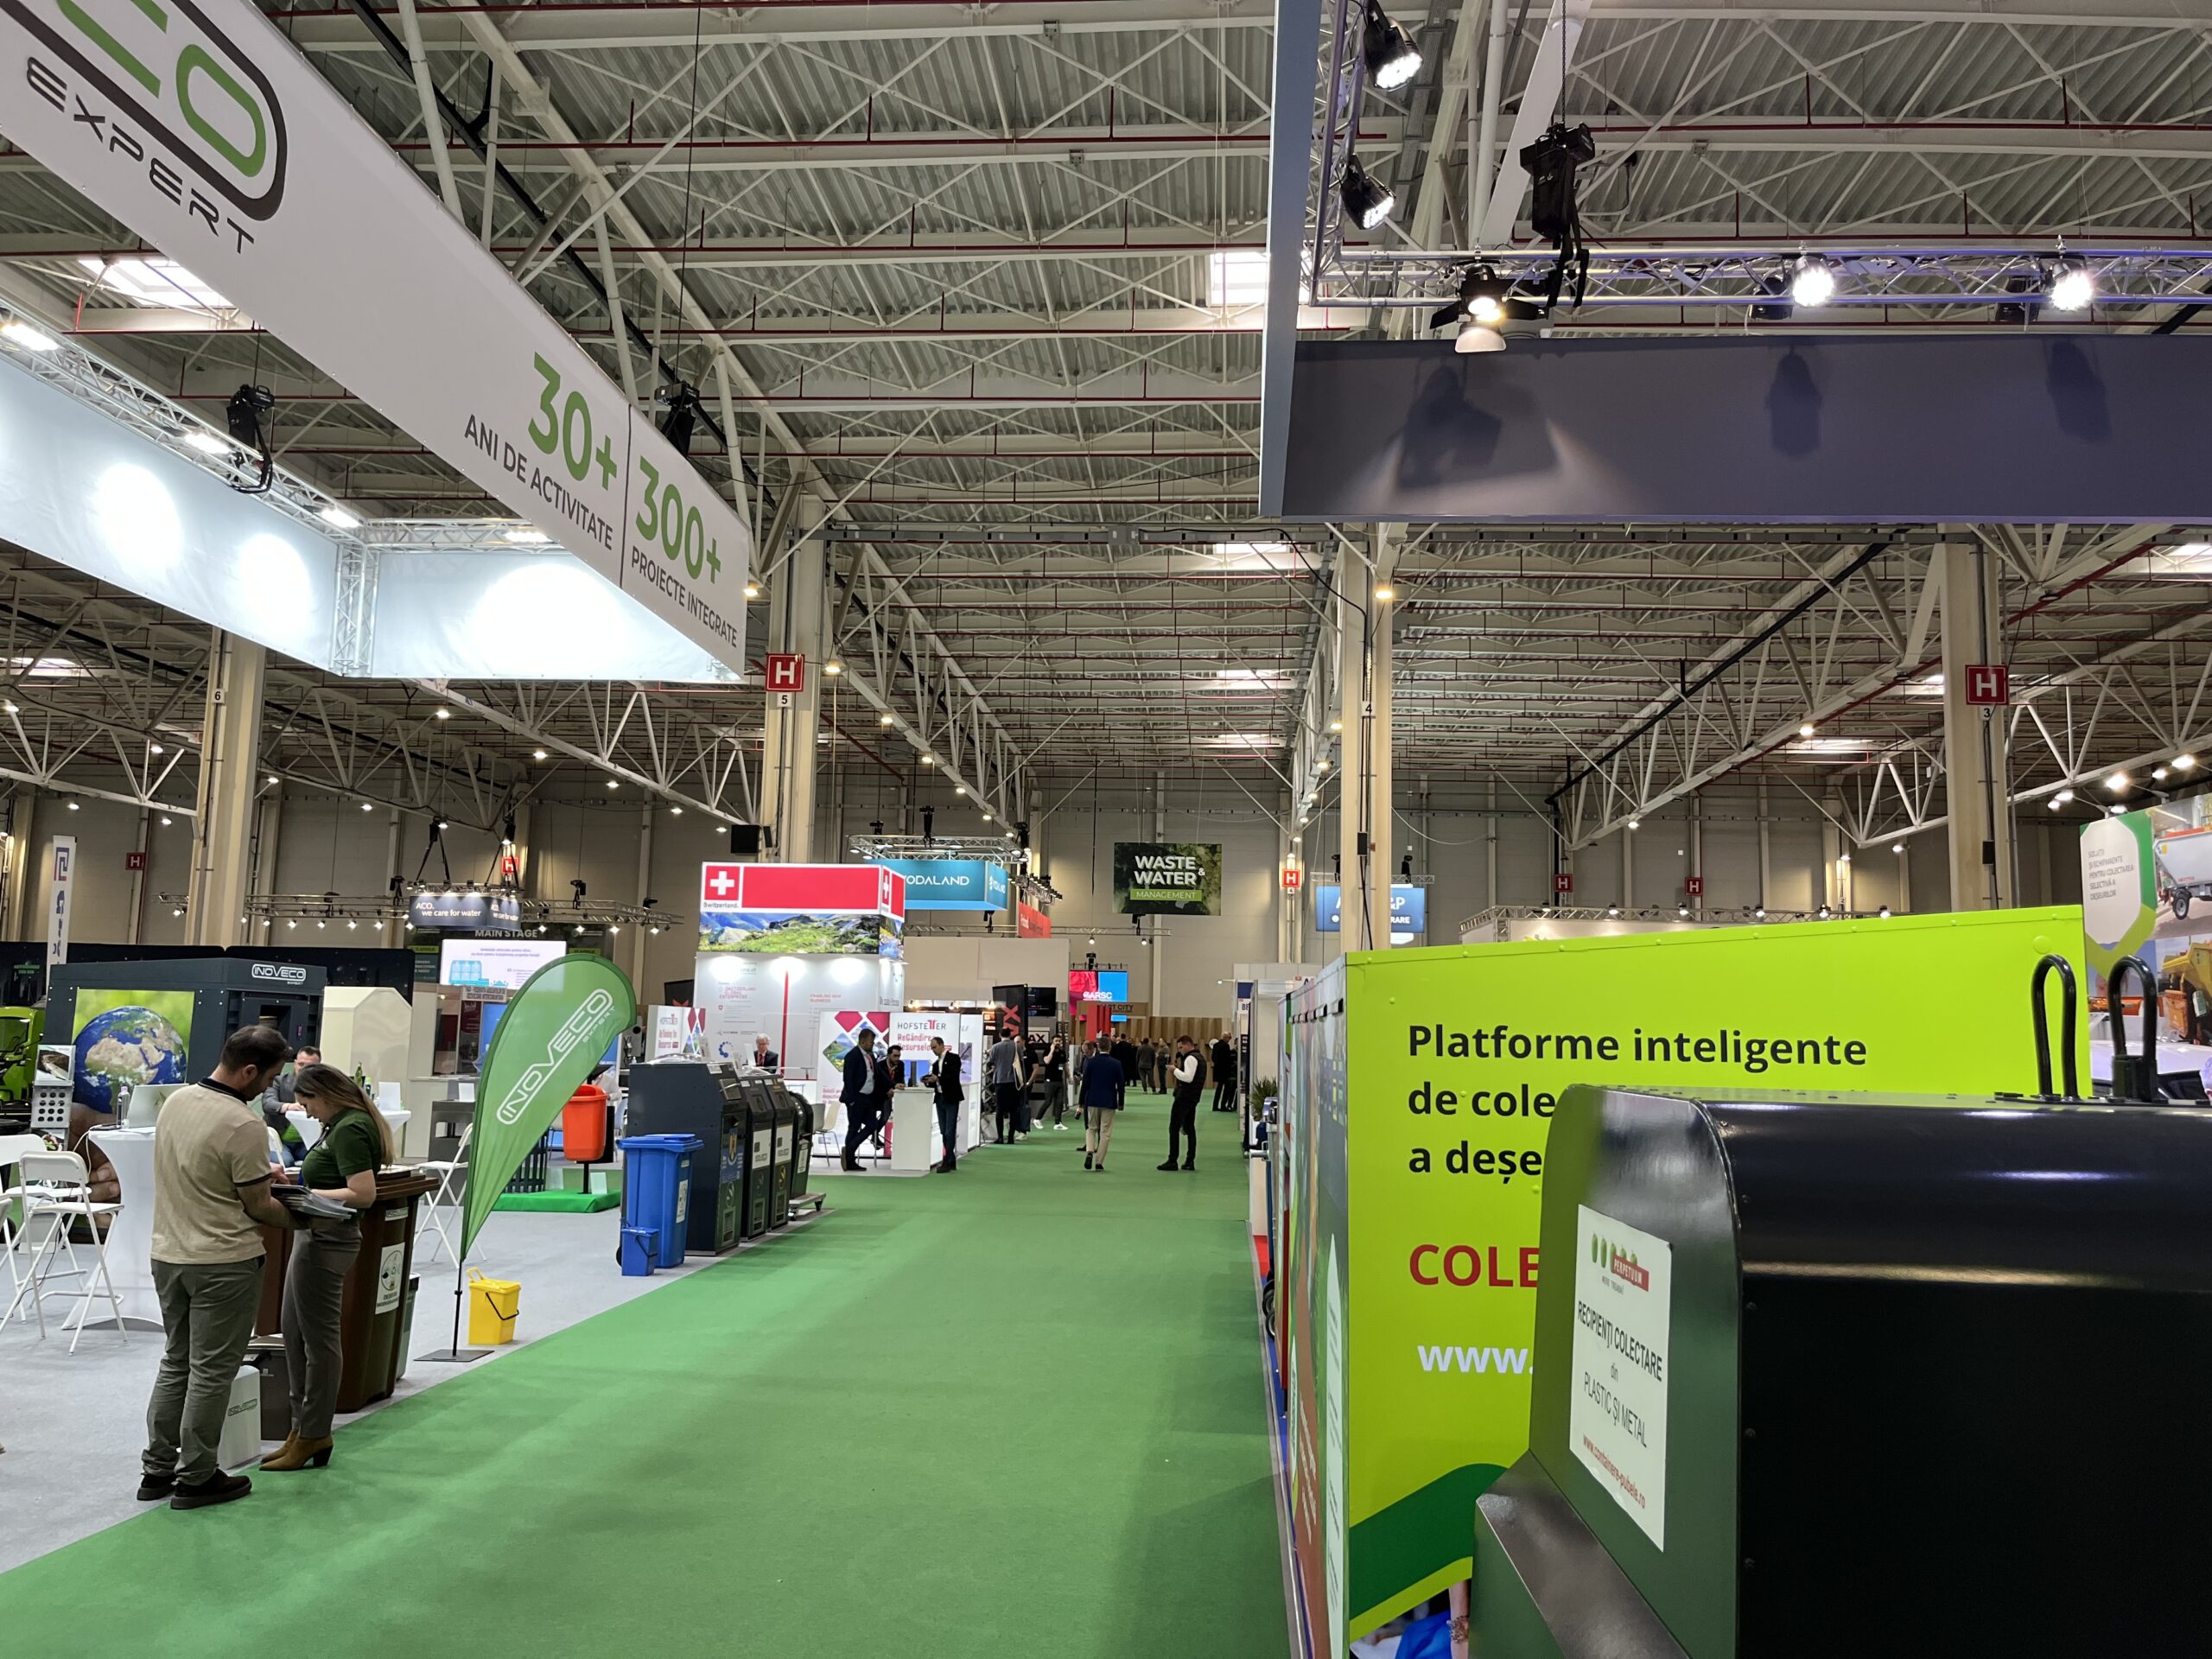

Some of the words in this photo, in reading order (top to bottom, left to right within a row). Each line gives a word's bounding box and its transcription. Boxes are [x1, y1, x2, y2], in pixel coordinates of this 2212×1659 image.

[27, 56, 254, 254] EXPERT
[528, 352, 617, 491] 30+
[464, 414, 498, 461] ANI
[504, 442, 527, 483] DE
[531, 467, 613, 550] ACTIVITATE
[636, 455, 721, 584] 300+
[632, 546, 684, 607] PROIECTE
[688, 592, 737, 648] INTEGRATE
[775, 661, 795, 684] H
[1975, 672, 1998, 698] H
[214, 691, 221, 701] 6
[781, 695, 788, 705] 5
[1365, 703, 1372, 714] 4
[1983, 708, 1991, 719] 3
[130, 856, 140, 868] H
[505, 860, 514, 872] H
[1135, 855, 1197, 870] WASTE
[904, 875, 969, 886] ODALAND
[1134, 871, 1198, 886] WATER
[1198, 868, 1205, 876] &
[1286, 873, 1296, 884] H
[1558, 878, 1568, 889] H
[1689, 880, 1700, 893] H
[1136, 891, 1196, 899] MANAGEMENT
[505, 929, 537, 938] STAGE
[253, 965, 305, 980] INOVECO
[898, 1020, 946, 1030] HOFSTETTER
[500, 991, 610, 1121] INOVECO
[1408, 1025, 1618, 1061] Platforme
[1634, 1028, 1866, 1072] inteligente
[1408, 1082, 1458, 1115] de
[1471, 1084, 1556, 1118] cole
[1408, 1147, 1431, 1173] a
[1446, 1141, 1541, 1184] deșe
[1408, 1244, 1539, 1287] COLE
[1613, 1258, 1643, 1284] PERPETUUM
[1418, 1345, 1533, 1375] www.
[1615, 1329, 1662, 1382] COLECTARE
[1584, 1371, 1612, 1414] PLASTIC
[1622, 1404, 1648, 1449] METAL
